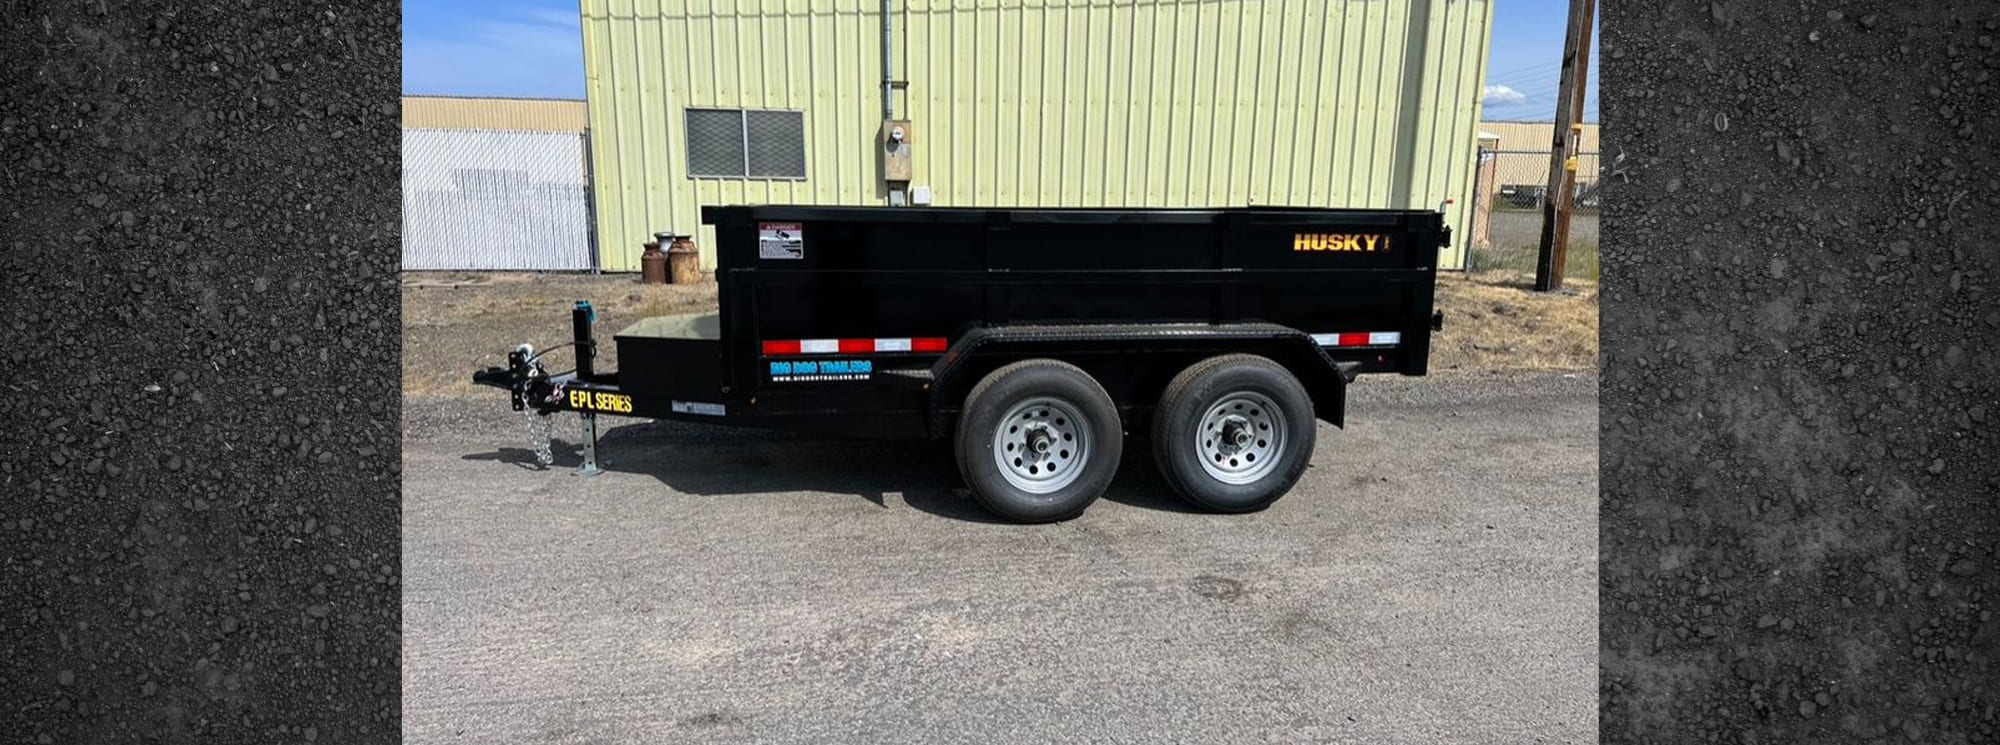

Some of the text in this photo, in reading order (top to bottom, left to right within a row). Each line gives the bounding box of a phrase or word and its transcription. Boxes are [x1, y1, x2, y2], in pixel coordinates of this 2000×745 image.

[1294, 233, 1380, 251] HUSKY
[770, 360, 873, 375] BIG DOG TRAILERS
[570, 390, 632, 413] EPL SERIES
